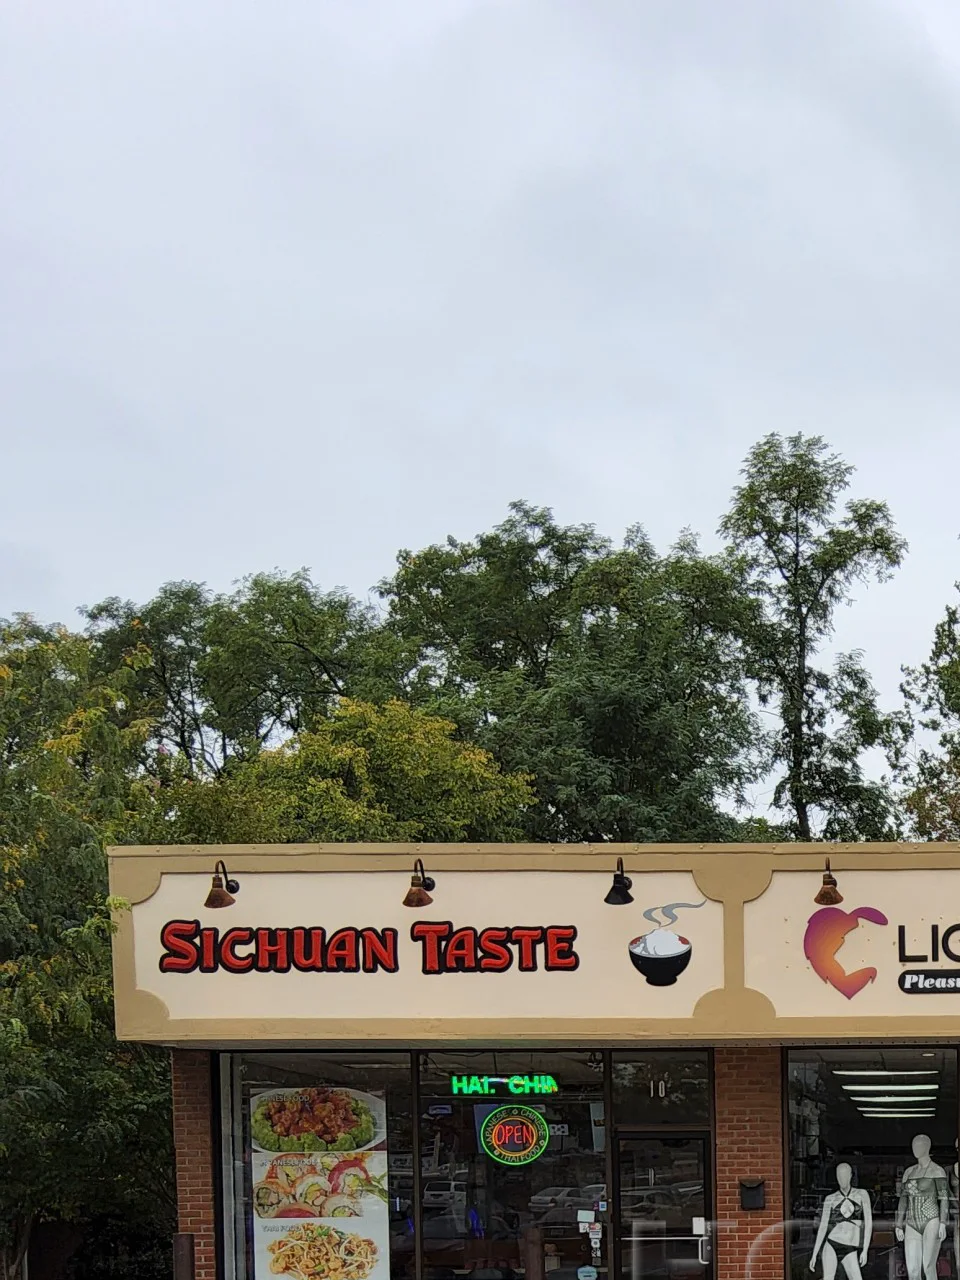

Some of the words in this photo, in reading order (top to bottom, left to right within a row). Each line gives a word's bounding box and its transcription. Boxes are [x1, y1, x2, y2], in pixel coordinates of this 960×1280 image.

[159, 918, 399, 974] SICHUAN
[410, 920, 581, 974] TASTE
[495, 1124, 533, 1145] OPEN
